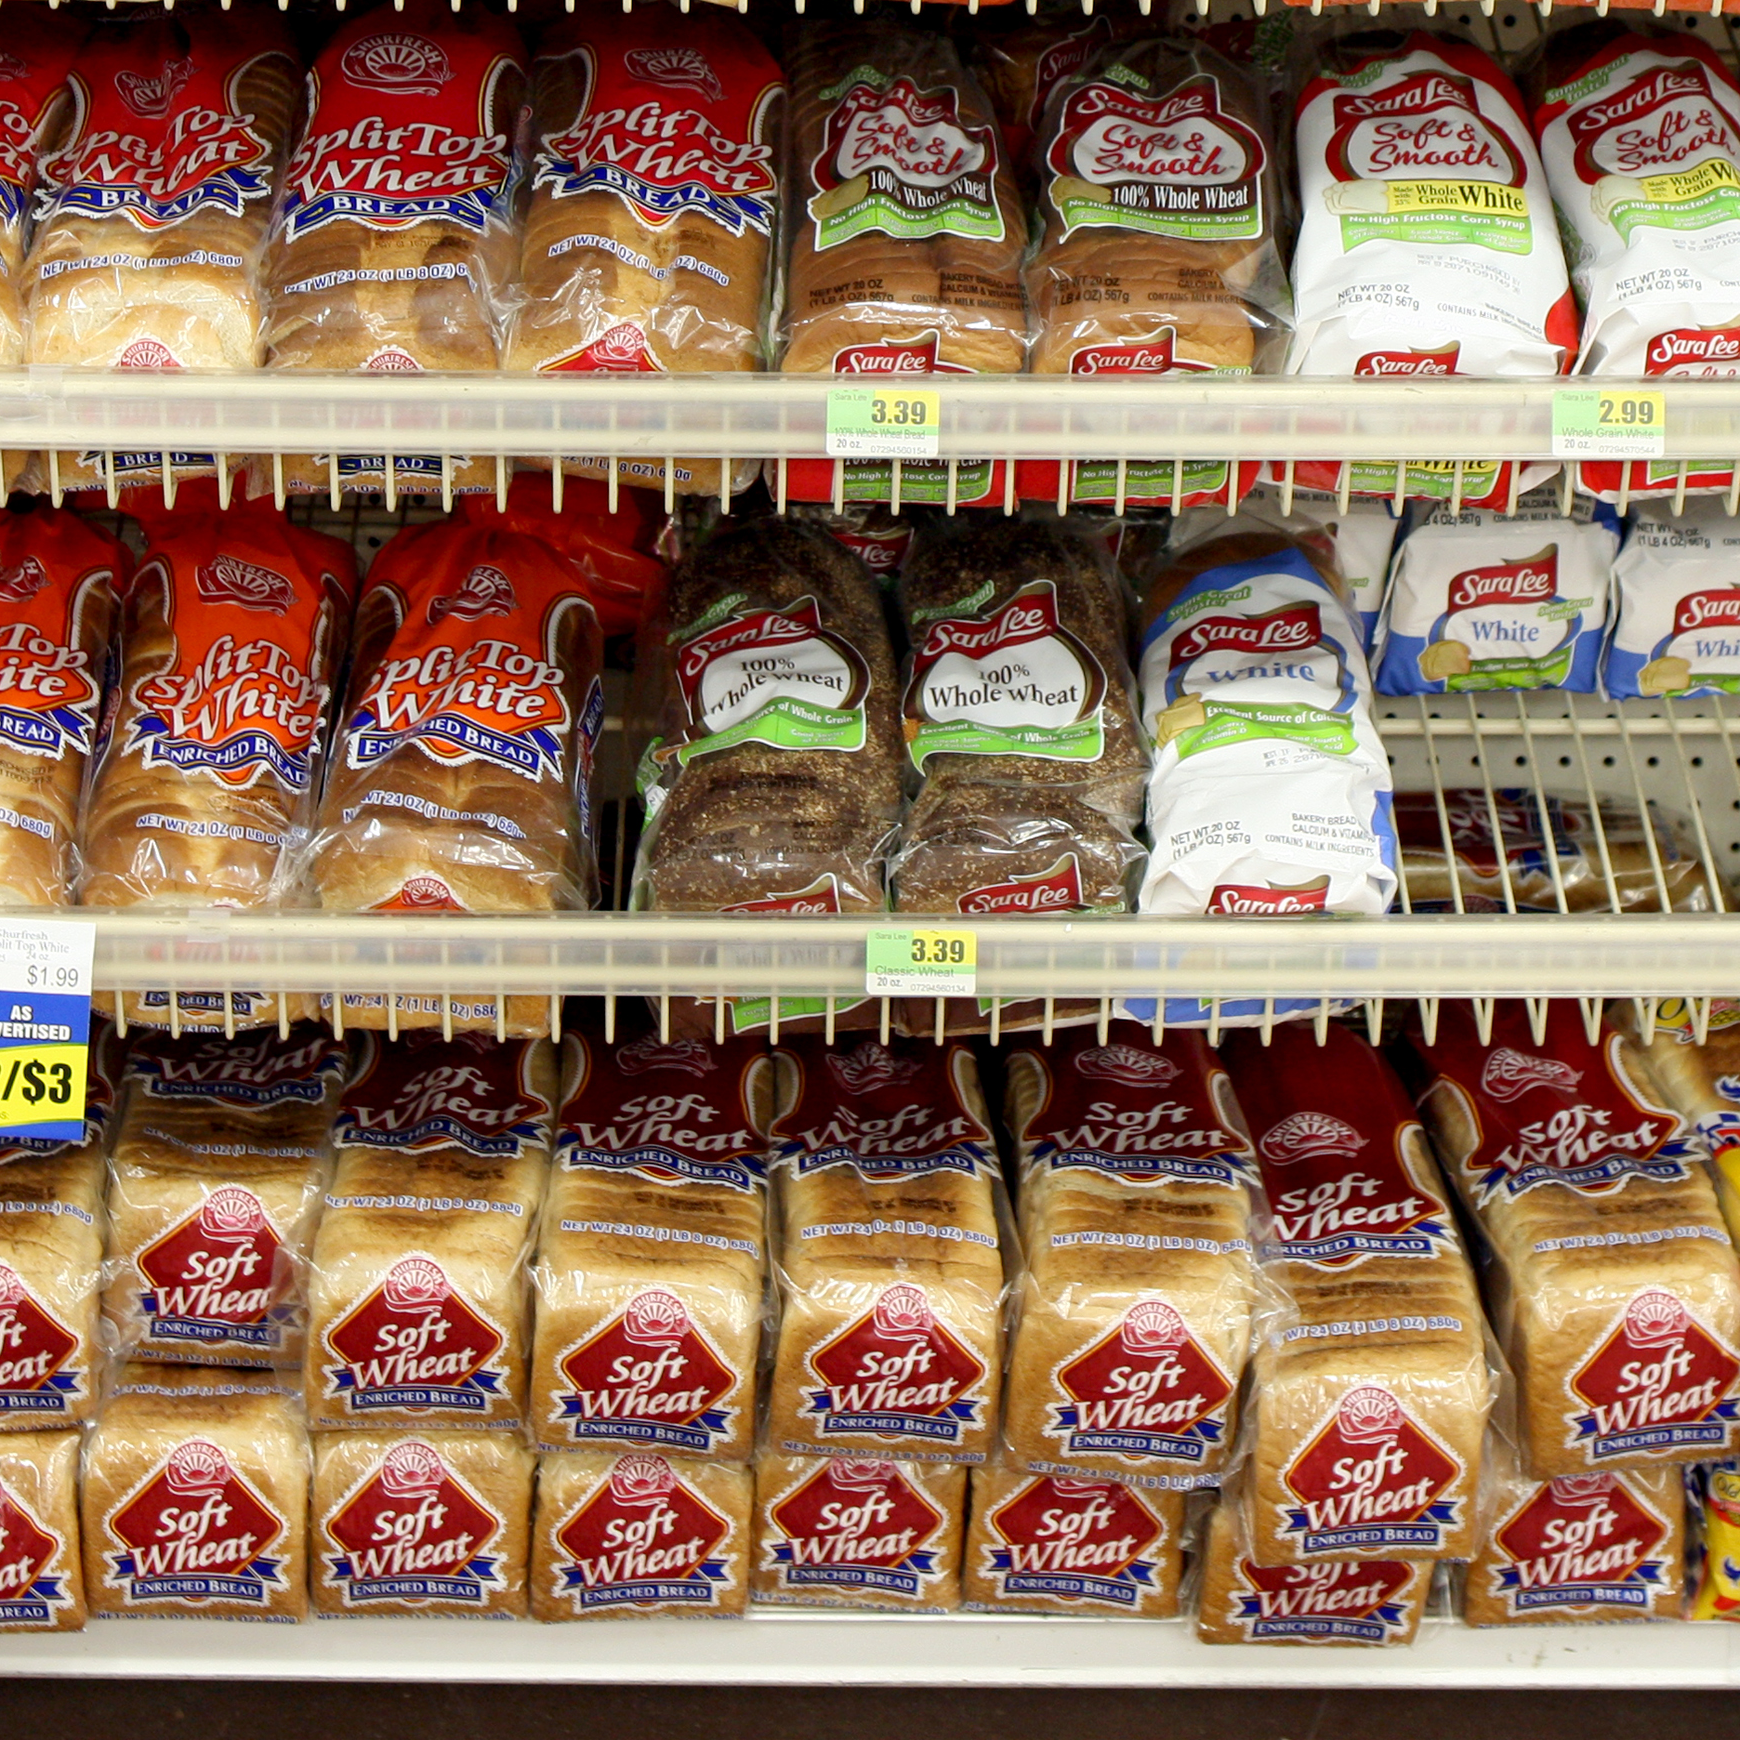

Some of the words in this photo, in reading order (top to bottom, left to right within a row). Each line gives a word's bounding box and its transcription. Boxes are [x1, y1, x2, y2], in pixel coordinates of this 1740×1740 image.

[290, 117, 408, 178] Split
[409, 123, 507, 164] Top
[1100, 125, 1182, 158] Soft
[1185, 132, 1208, 153] &
[1092, 148, 1227, 176] Smooth
[297, 154, 498, 205] Wheat
[333, 197, 451, 214] BREAD
[1114, 187, 1150, 208] 100%
[1154, 188, 1200, 209] Whole
[1205, 186, 1248, 208] Wheat
[1458, 183, 1523, 212] White
[1349, 216, 1363, 224] No
[1367, 216, 1398, 225] High
[1403, 214, 1457, 224] Fructose
[1461, 215, 1490, 224] Corn
[1495, 217, 1526, 231] Syrup
[872, 400, 926, 424] 3.39
[1600, 400, 1654, 424] 2.99
[835, 428, 850, 438] 100%
[852, 429, 877, 438] Whole
[879, 429, 900, 438] Wheat
[902, 430, 926, 440] Bread
[1562, 428, 1593, 438] Whole
[1596, 428, 1623, 438] Grain
[1626, 428, 1654, 439] White
[1565, 439, 1575, 448] 20
[1454, 571, 1514, 603] Sara
[1510, 568, 1552, 597] Lee
[1471, 621, 1539, 642] White
[912, 938, 965, 962] 3.39
[27, 965, 78, 987] $1.99
[876, 966, 915, 977] Classic
[918, 967, 954, 978] Wheat
[877, 978, 887, 987] 20
[10, 1004, 32, 1020] AS
